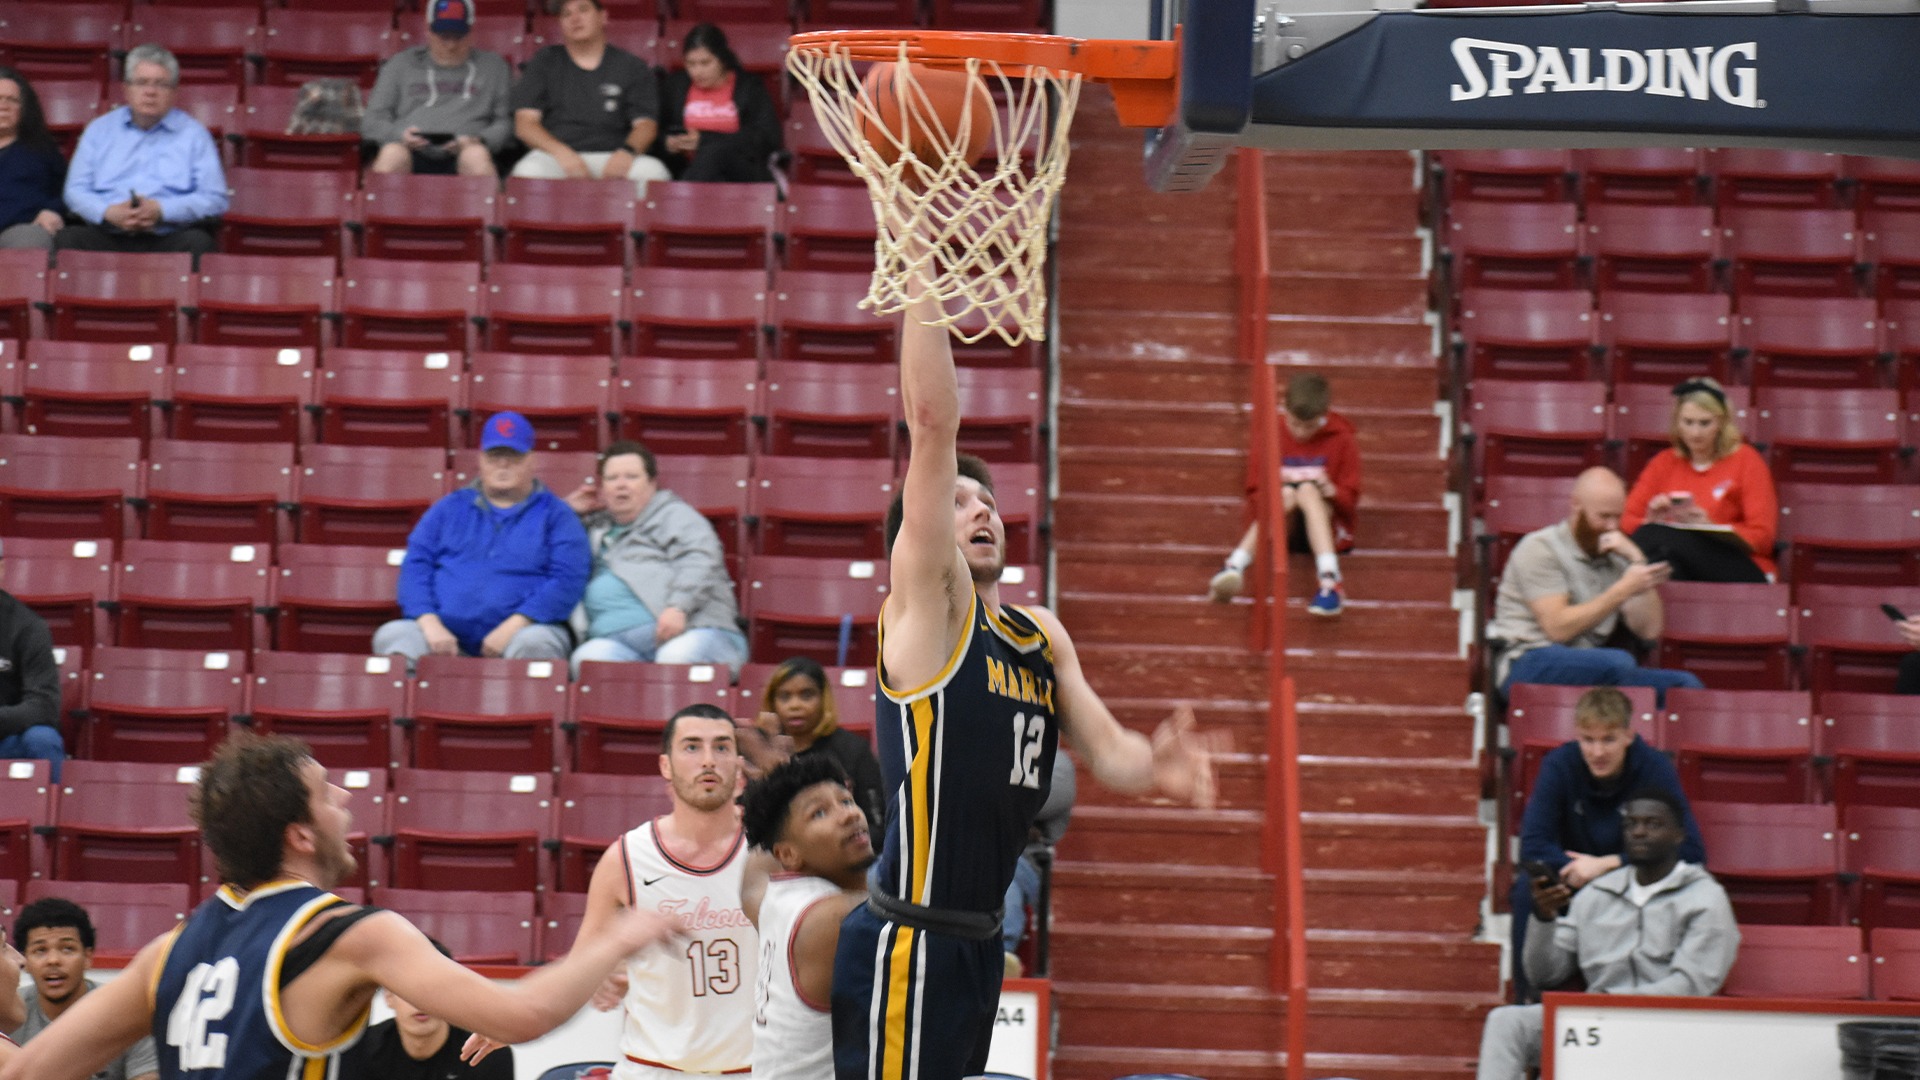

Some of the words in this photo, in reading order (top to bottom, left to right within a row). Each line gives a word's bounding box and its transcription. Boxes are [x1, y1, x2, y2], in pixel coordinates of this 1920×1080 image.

[1450, 37, 1757, 108] SPALDING
[1010, 711, 1046, 789] 12
[687, 938, 740, 997] 13
[166, 956, 240, 1072] 42
[994, 1007, 1024, 1026] A4
